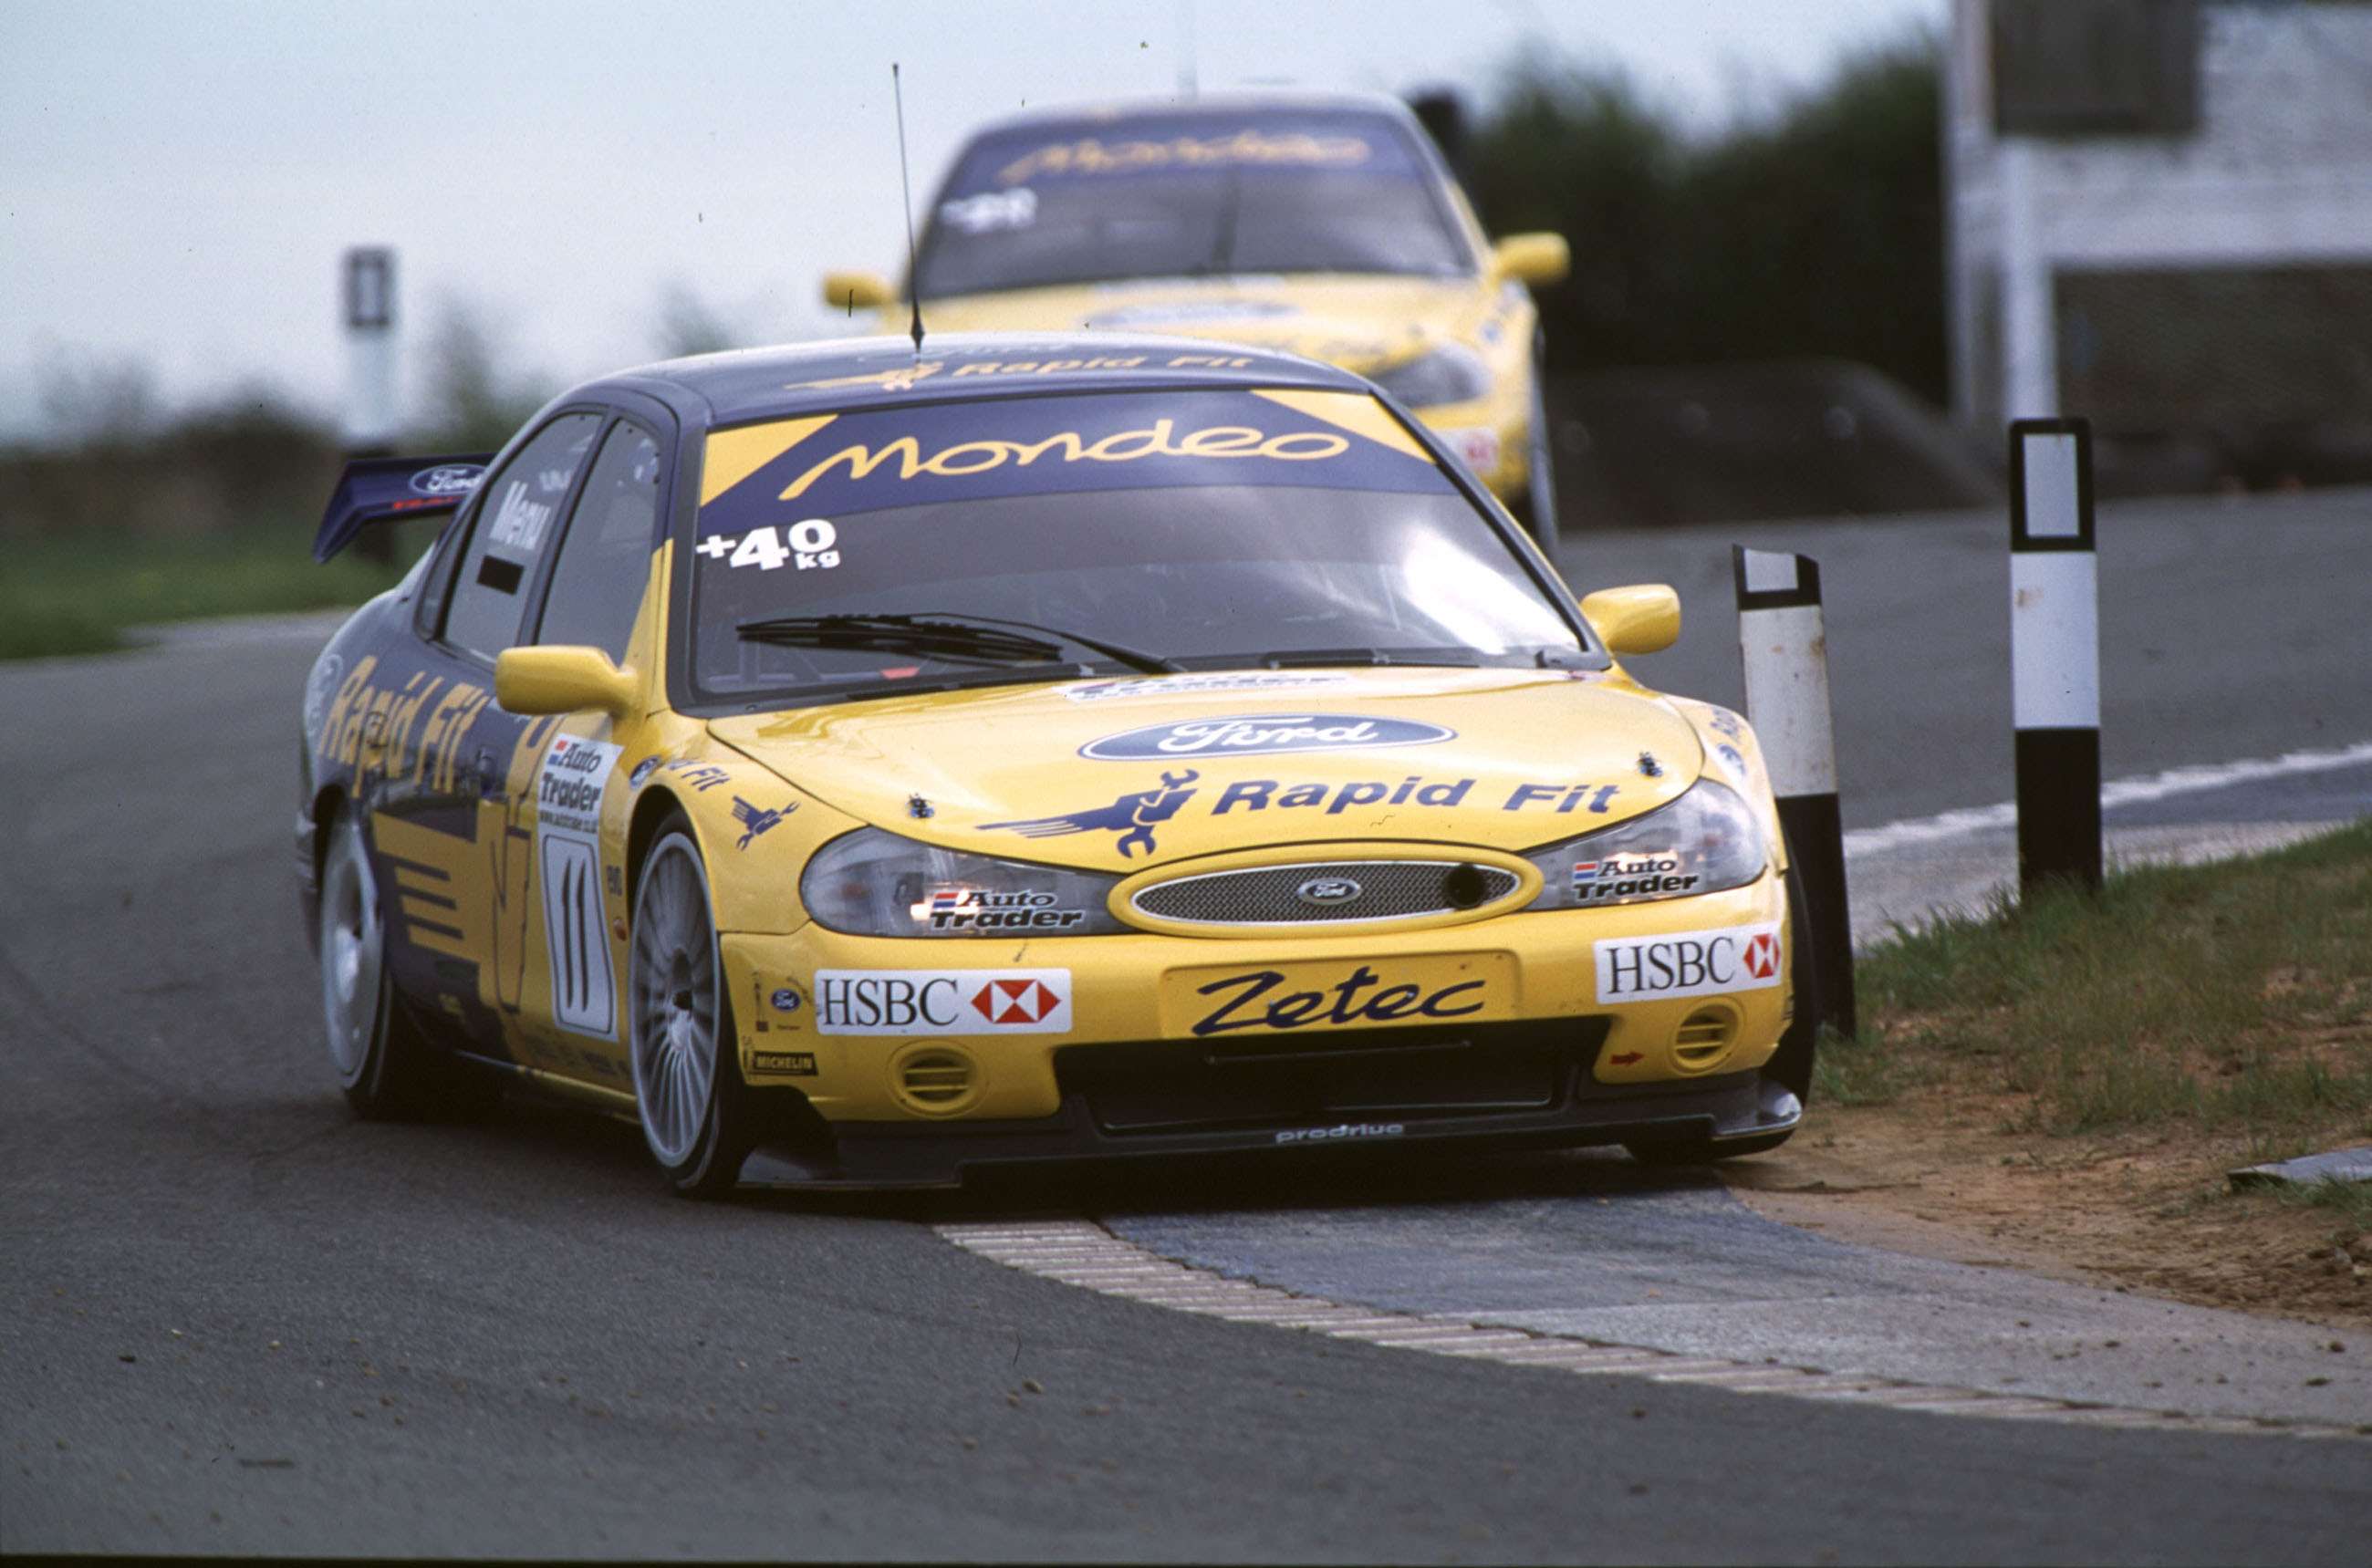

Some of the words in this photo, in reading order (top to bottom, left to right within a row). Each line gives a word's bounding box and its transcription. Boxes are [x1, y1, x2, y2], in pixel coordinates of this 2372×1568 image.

[778, 418, 1349, 501] Mondeo
[795, 550, 841, 571] kg
[413, 682, 491, 794] Fit
[1157, 717, 1379, 752] Ford
[557, 742, 602, 774] Auto
[541, 772, 602, 812] Trader
[1210, 775, 1476, 815] Rapid
[1502, 784, 1620, 814] Fit
[1597, 859, 1677, 877] Auto
[956, 889, 1056, 908] Auto
[1573, 873, 1700, 899] Trader
[931, 909, 1084, 929] Trader
[1606, 935, 1735, 994] HSBC
[822, 977, 959, 1027] HSBC
[1191, 965, 1486, 1036] Zetec
[755, 1055, 813, 1069] MICHELIN
